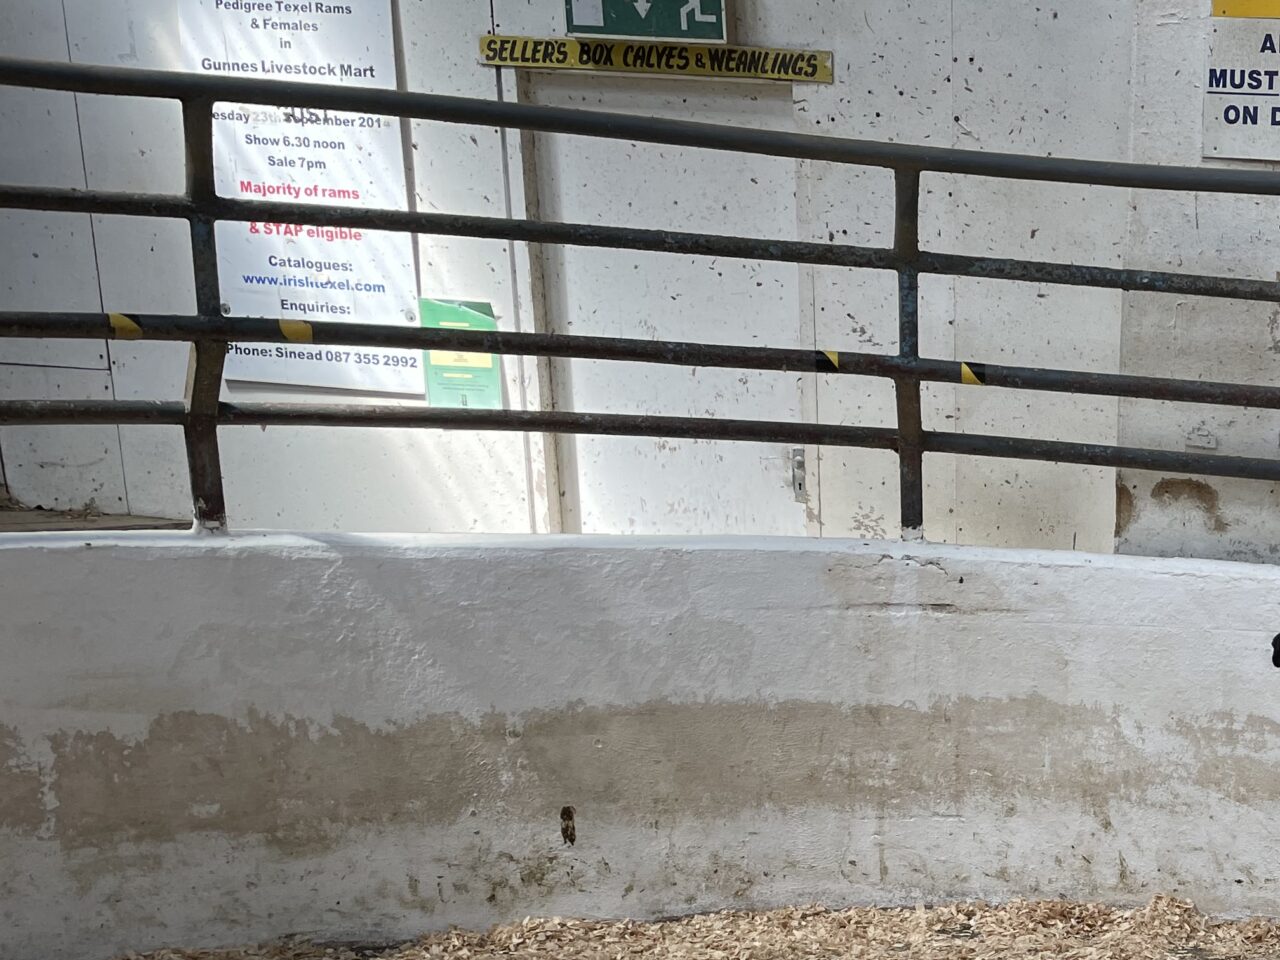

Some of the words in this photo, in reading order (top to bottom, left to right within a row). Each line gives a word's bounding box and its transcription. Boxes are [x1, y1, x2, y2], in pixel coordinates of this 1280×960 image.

[215, 0, 272, 13] Pedigree
[275, 0, 312, 14] Texel
[315, 3, 352, 14] Rams
[250, 18, 260, 30] &
[263, 18, 319, 31] Females
[279, 38, 291, 49] in
[485, 39, 568, 63] SELLER'S
[578, 42, 614, 66] BOX
[695, 52, 706, 69] &
[708, 48, 818, 77] WEANLINGS
[201, 57, 258, 73] Gunnes
[261, 60, 337, 77] Livestock
[340, 63, 376, 78] Mart
[1208, 68, 1279, 90] MUST
[213, 110, 250, 124] esday
[1223, 105, 1259, 125] ON
[244, 134, 280, 146] Show
[283, 135, 311, 148] 6.30
[313, 139, 345, 150] noon
[267, 155, 296, 168] Sale
[299, 156, 327, 171] 7pm
[240, 180, 301, 197] Majority
[304, 185, 319, 197] of
[322, 187, 360, 199] rams
[249, 221, 260, 234] &
[306, 226, 362, 242] eligible
[268, 255, 353, 272] Catalogues:
[280, 299, 351, 315] Enquiries:
[227, 343, 273, 357] Phone:
[275, 347, 323, 361] Sinead
[325, 350, 351, 364] 087
[354, 352, 380, 365] 355
[382, 354, 418, 368] 2992
